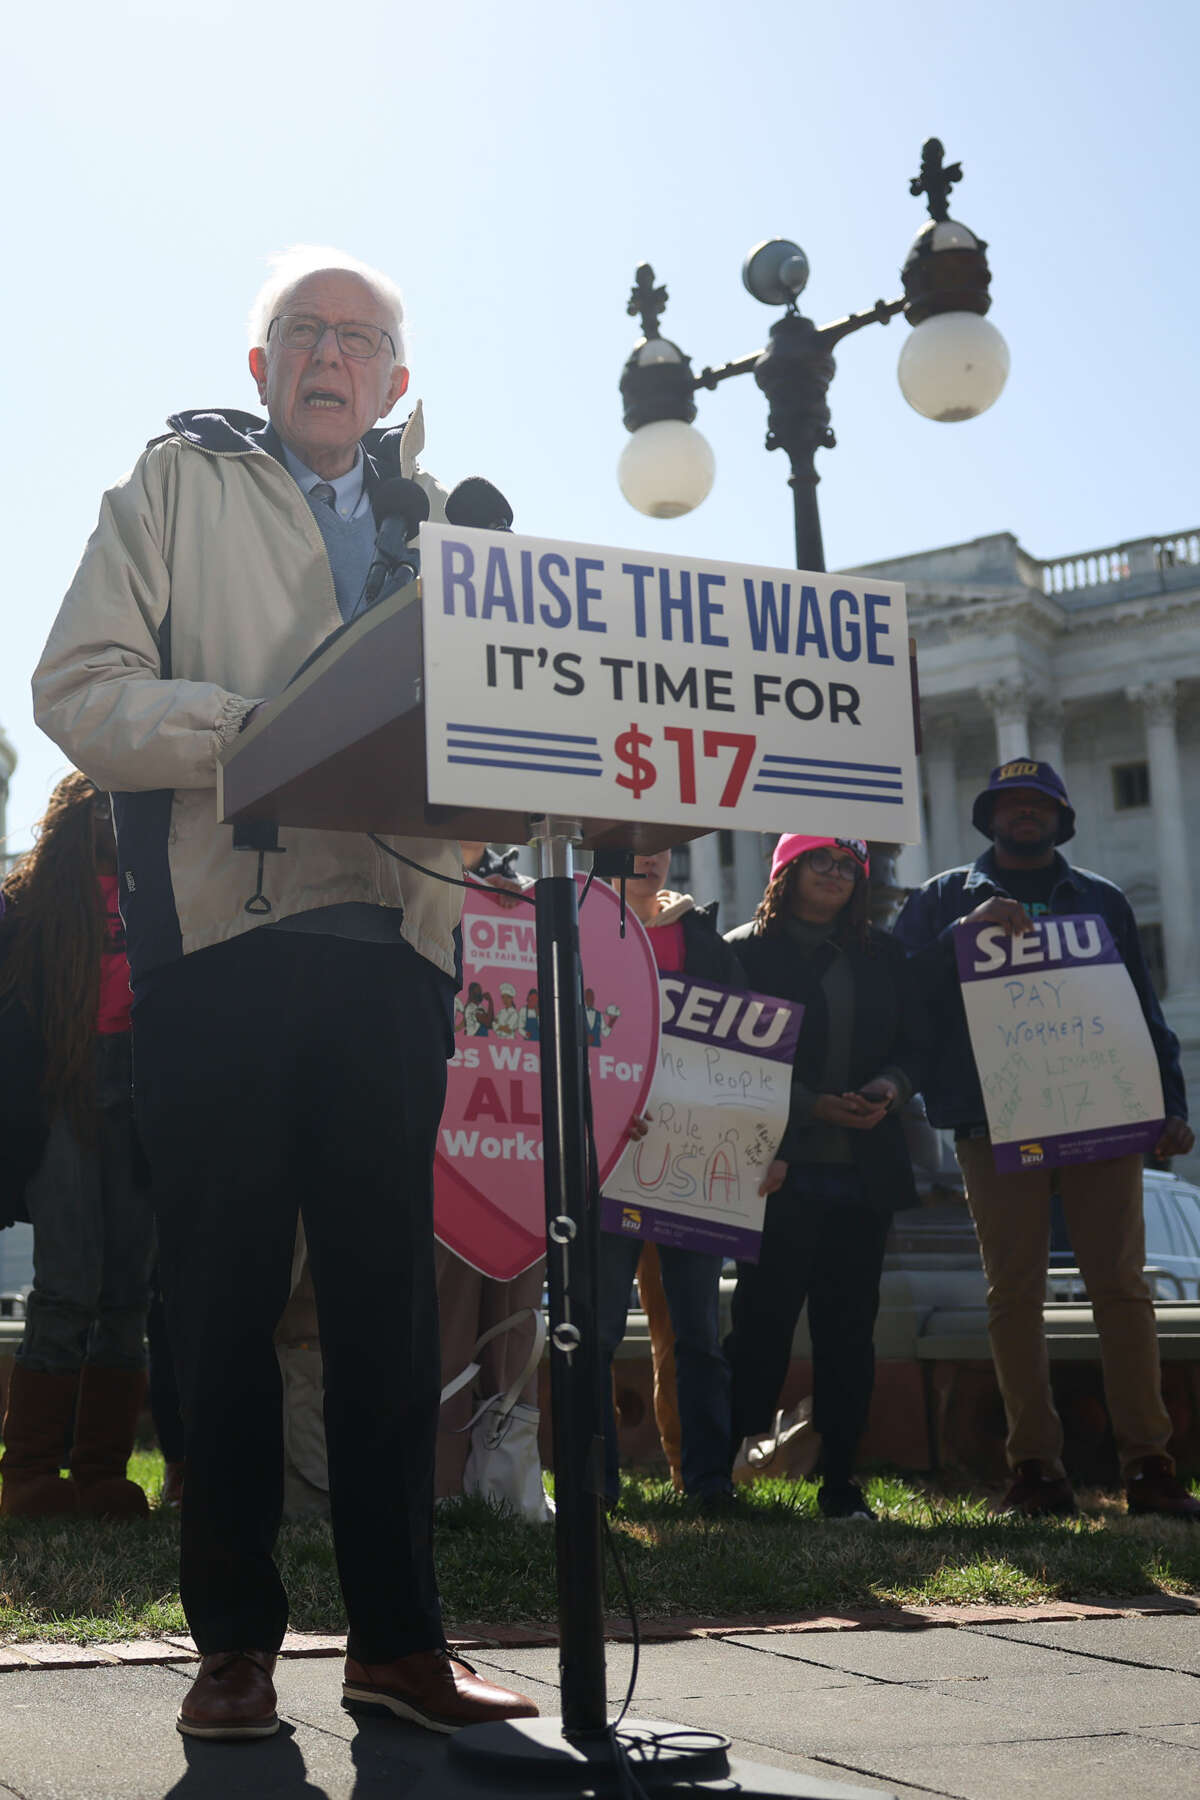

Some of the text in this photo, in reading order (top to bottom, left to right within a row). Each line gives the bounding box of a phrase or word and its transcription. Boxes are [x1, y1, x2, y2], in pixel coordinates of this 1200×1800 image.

[440, 539, 895, 667] RAISE THE WAGE
[485, 643, 862, 726] IT'S TIME FOR
[613, 721, 757, 808] $17
[997, 761, 1039, 782] SEIU
[974, 919, 1103, 973] SEIU
[660, 977, 792, 1049] SEIU
[1003, 980, 1067, 1009] PAY
[599, 1055, 644, 1083] For
[660, 1048, 687, 1081] he
[463, 1076, 541, 1126] AL
[442, 1128, 545, 1162] Work
[633, 1139, 741, 1203] USA
